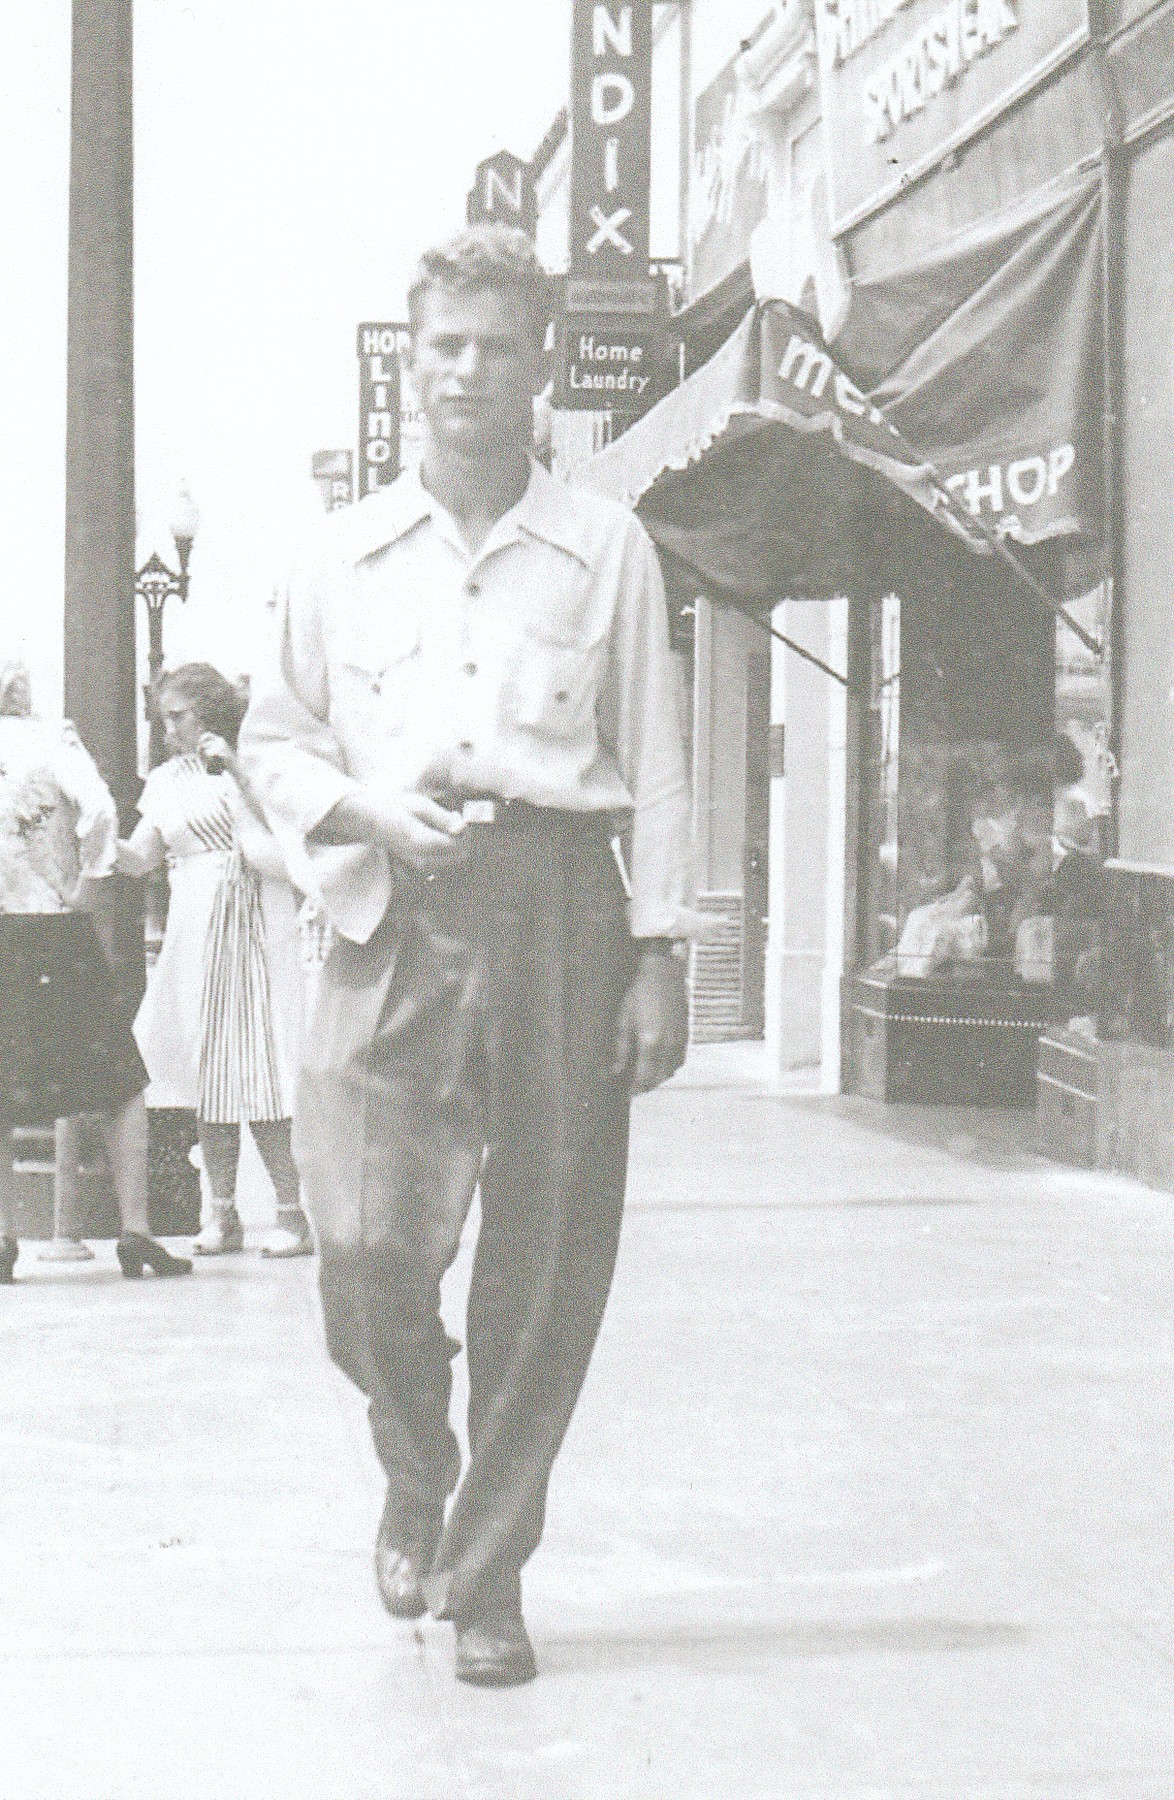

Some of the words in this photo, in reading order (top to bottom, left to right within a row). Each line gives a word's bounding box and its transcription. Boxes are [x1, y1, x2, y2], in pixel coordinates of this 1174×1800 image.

[587, 4, 634, 254] NDIX
[580, 336, 642, 361] Home
[570, 365, 650, 394] Laundry
